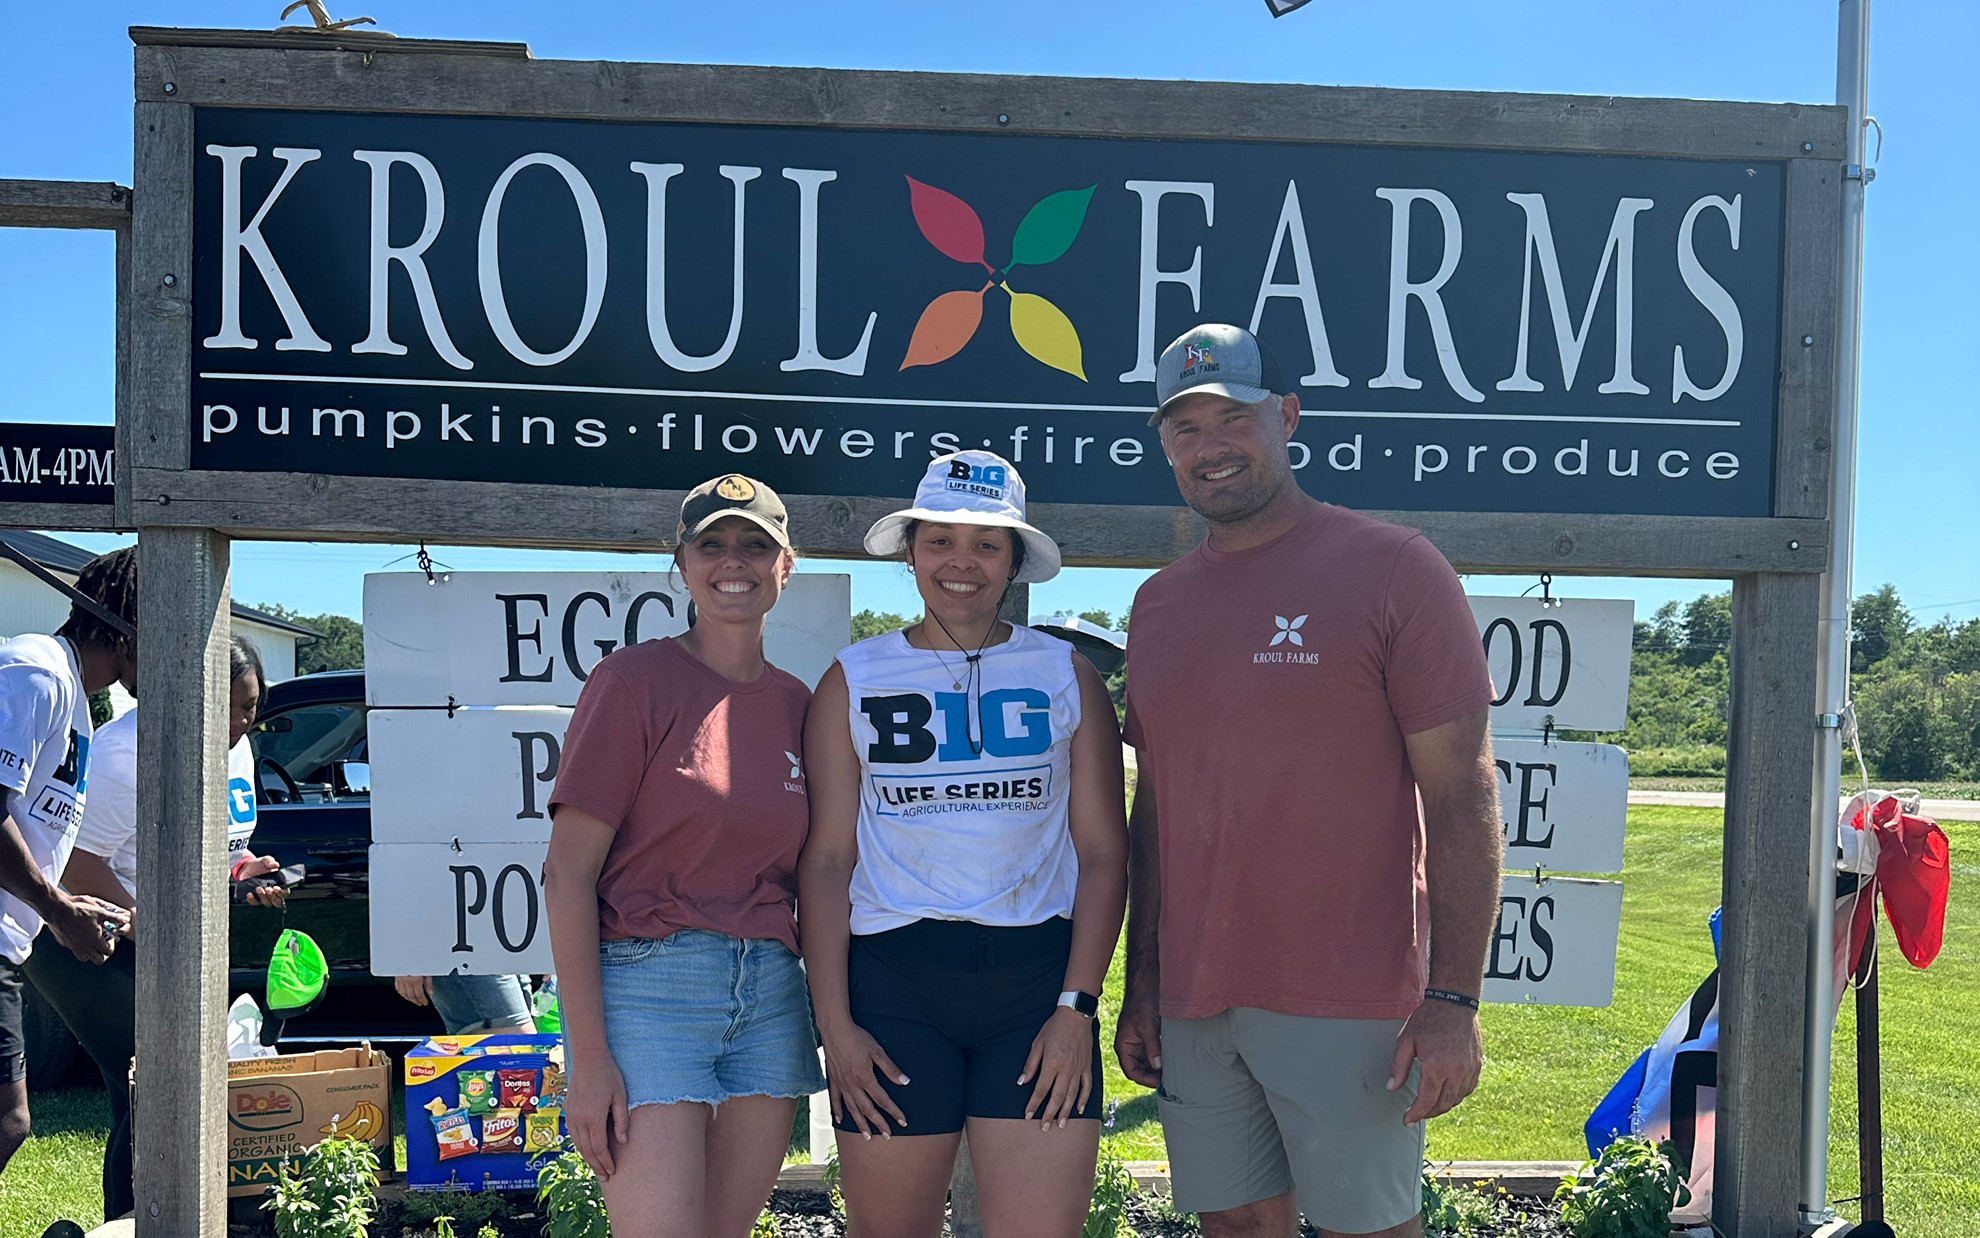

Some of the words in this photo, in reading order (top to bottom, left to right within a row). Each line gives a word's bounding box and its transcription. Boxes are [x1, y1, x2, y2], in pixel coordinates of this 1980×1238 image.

[203, 144, 878, 377] KROUL
[1119, 179, 1743, 404] FARMS
[203, 403, 608, 448] pumpkins
[657, 413, 961, 459] flowers
[1010, 426, 1362, 471] fireod
[1414, 438, 1740, 481] produce
[970, 484, 1000, 497] SERIES
[1253, 652, 1283, 664] KROUL
[1286, 652, 1319, 664] FARMS
[882, 786, 935, 806] LIFE
[945, 777, 1042, 799] SERIES
[41, 796, 72, 821] LIFE
[902, 802, 983, 818] AGRICULTURAL
[986, 800, 1050, 811] EXPERIENCE
[504, 1080, 531, 1088] Doritos
[236, 1090, 291, 1113] Dole
[485, 1117, 516, 1134] Fritos
[233, 1133, 296, 1146] CERTIFIED
